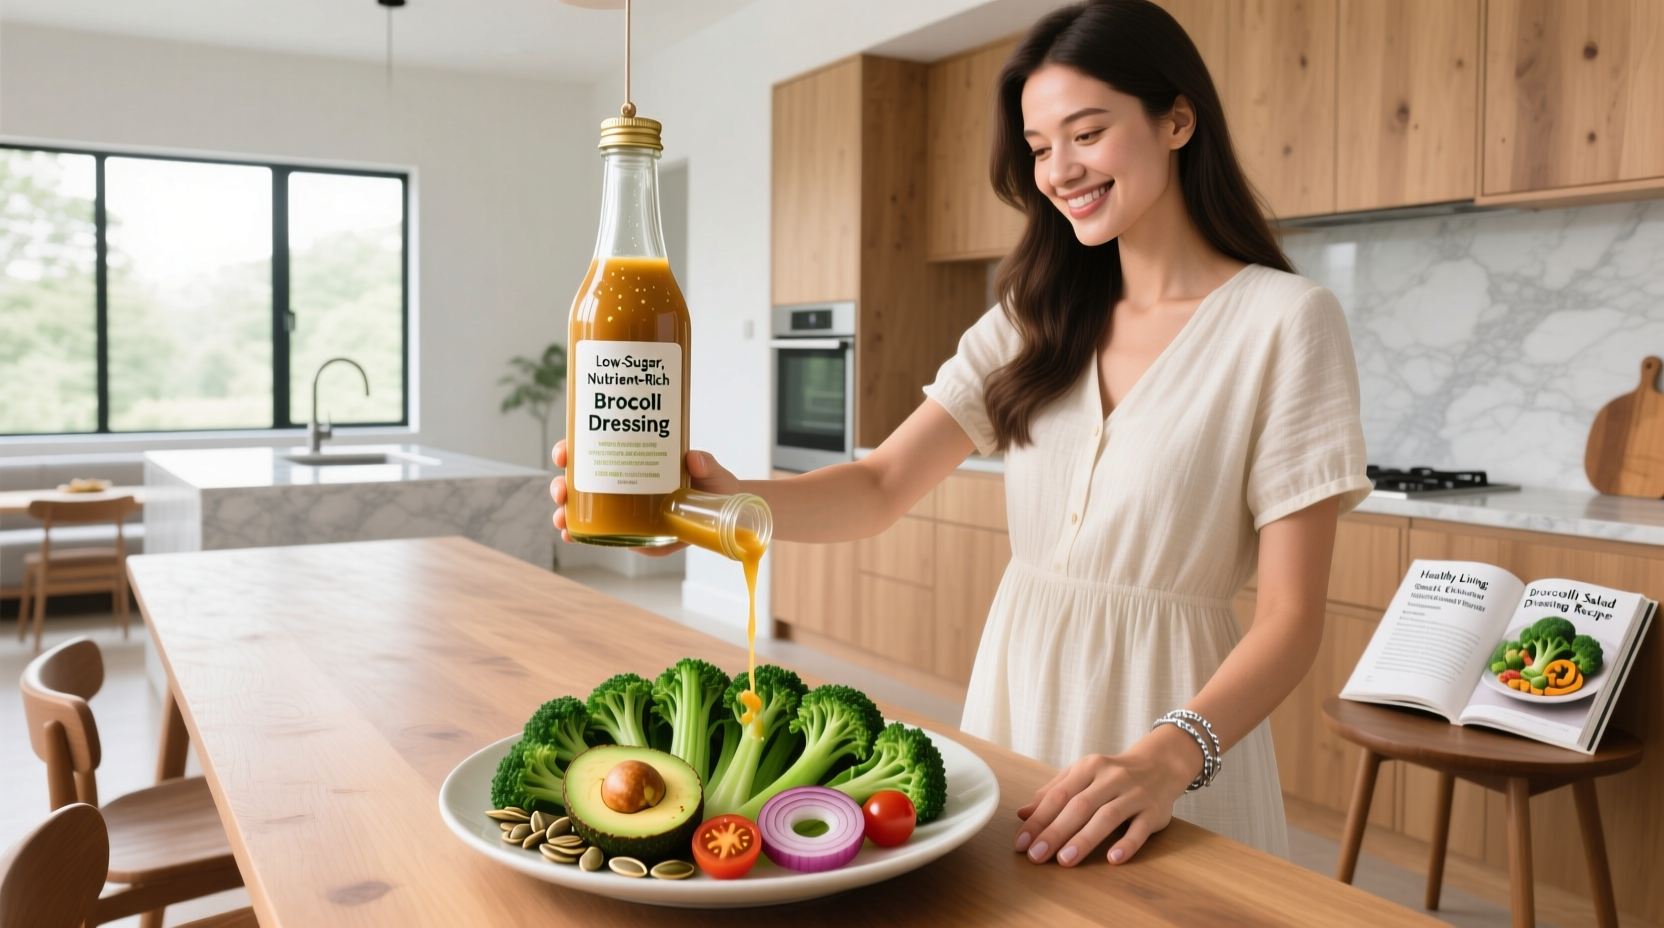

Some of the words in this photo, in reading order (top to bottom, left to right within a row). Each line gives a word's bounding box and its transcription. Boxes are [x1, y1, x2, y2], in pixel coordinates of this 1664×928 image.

[596, 354, 665, 372] Low-Sugar,
[587, 372, 670, 386] Nutrient-Rich
[594, 392, 662, 411] Brocoll
[588, 414, 670, 438] Dressing
